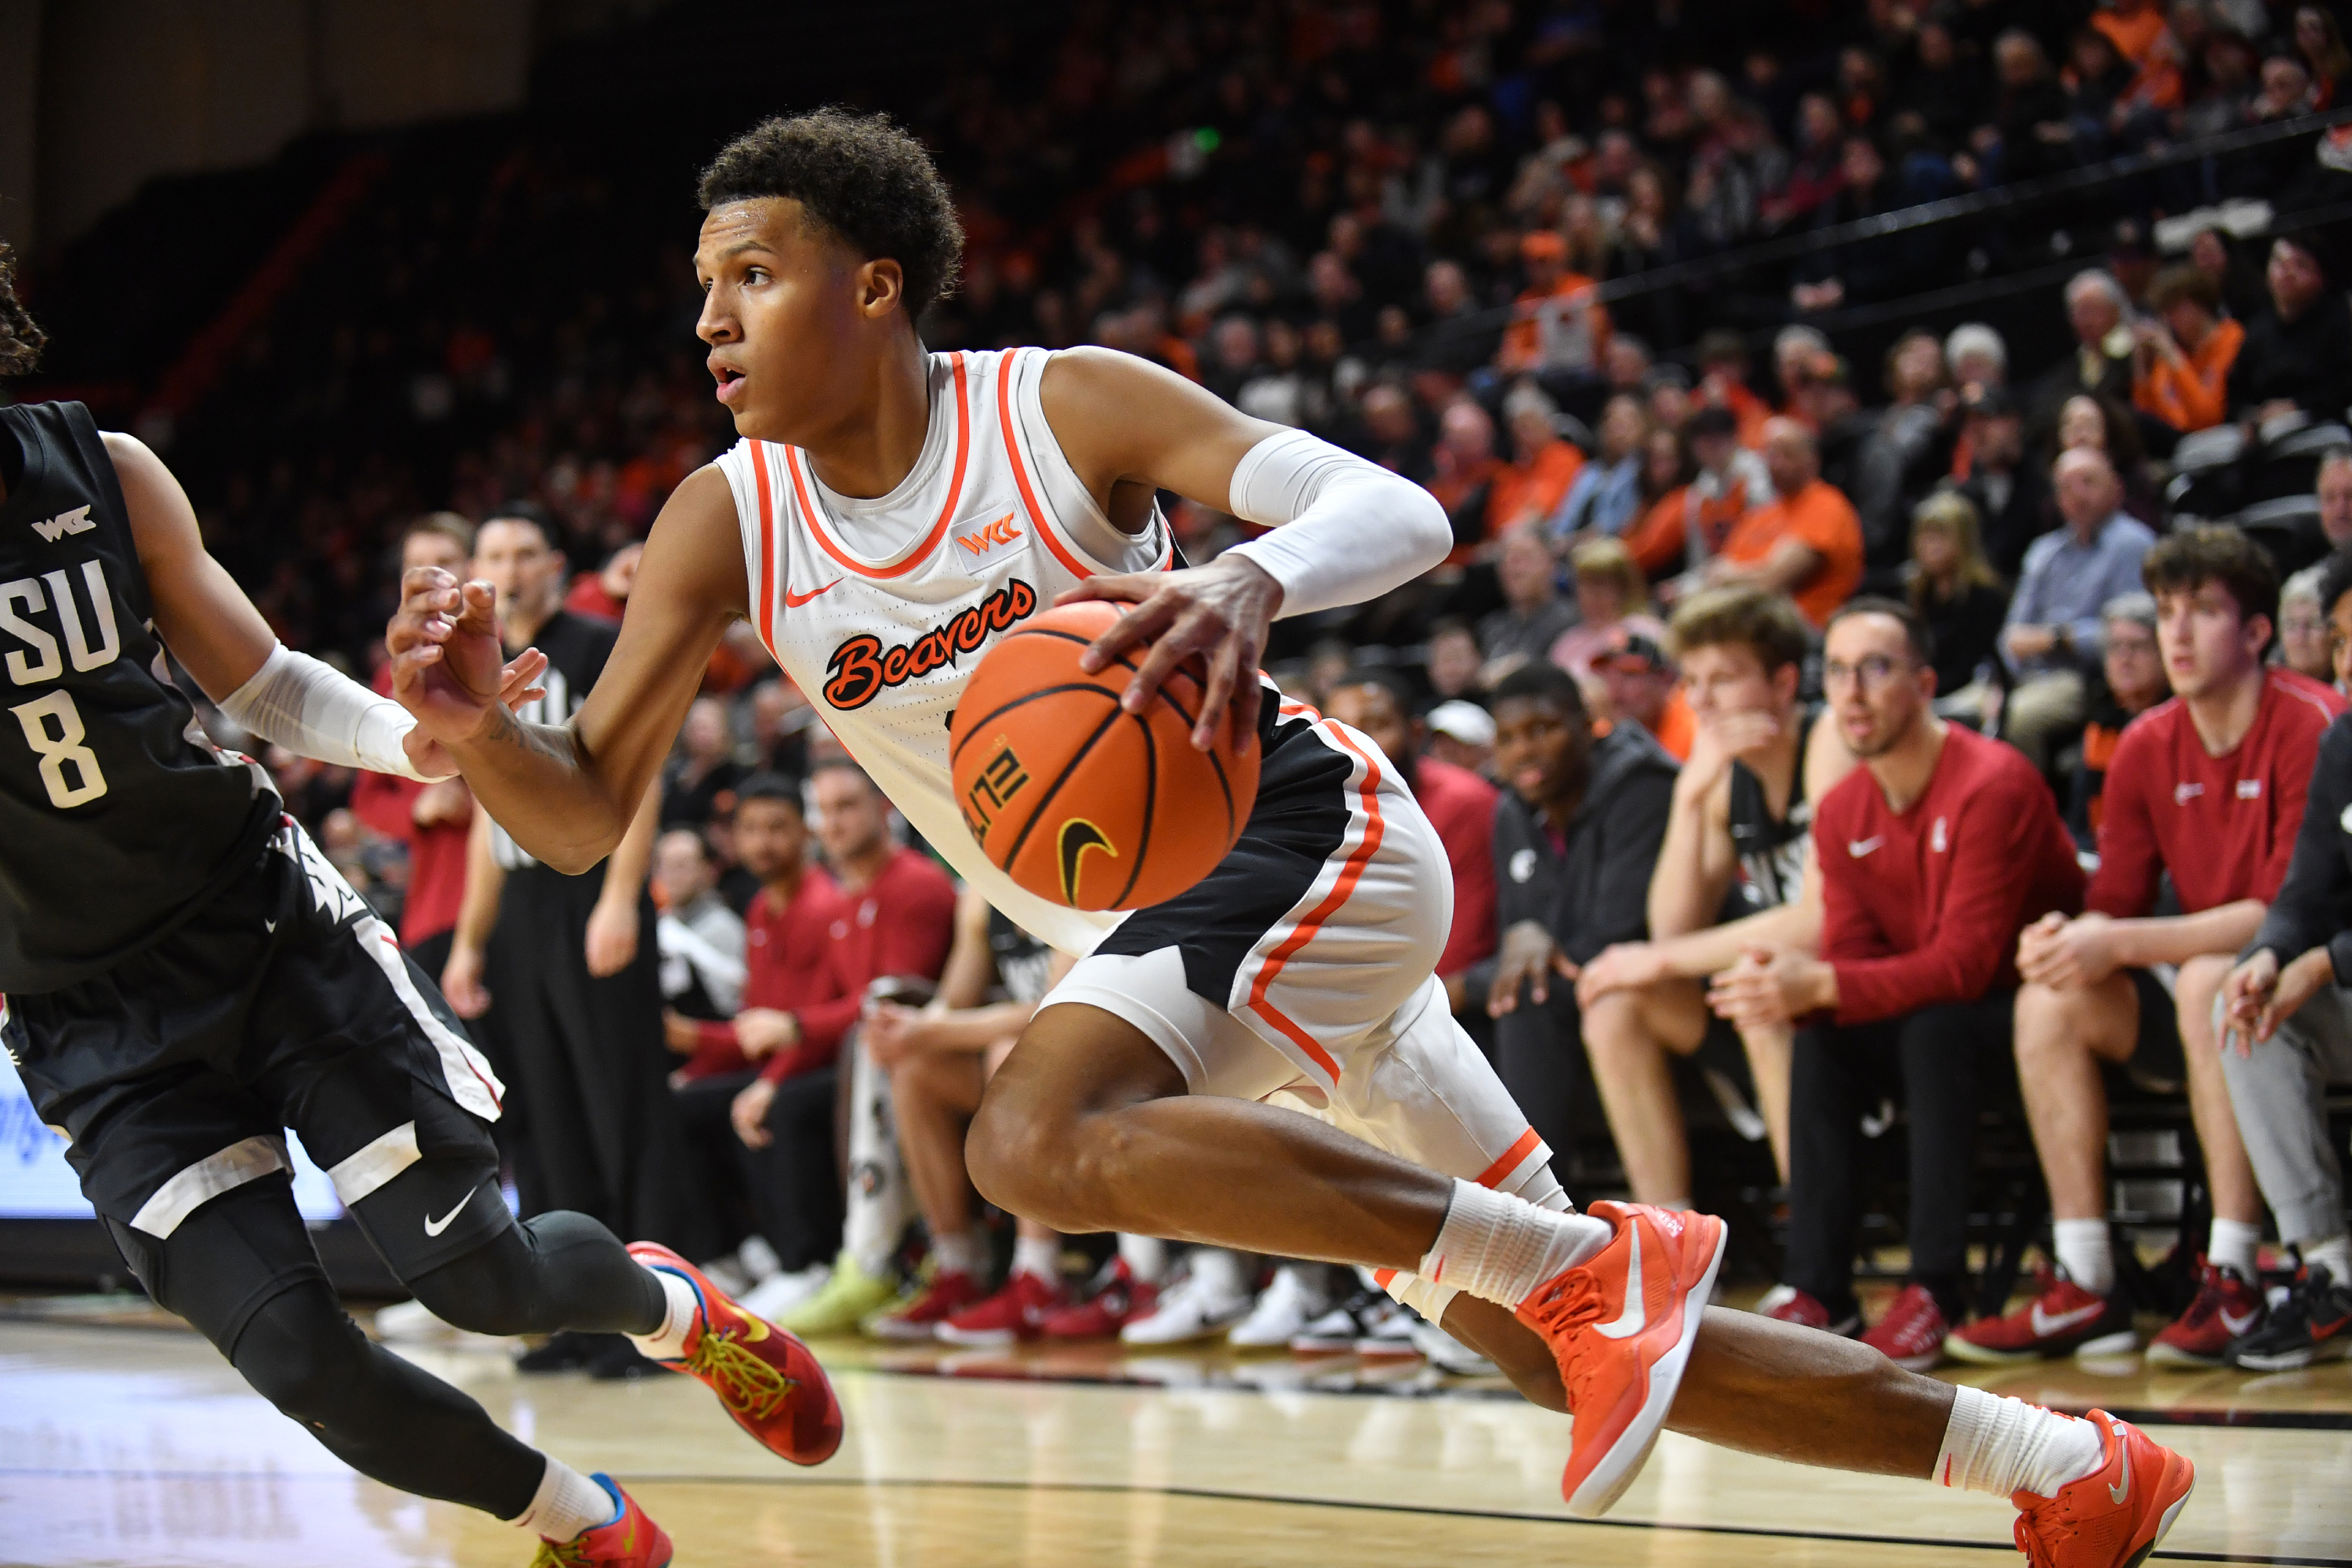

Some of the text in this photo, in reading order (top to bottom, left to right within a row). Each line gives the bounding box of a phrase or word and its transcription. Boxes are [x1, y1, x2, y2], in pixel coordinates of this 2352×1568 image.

[31, 504, 96, 543] WCC
[956, 511, 1022, 557] WCC
[822, 578, 1036, 711] Beavers
[8, 689, 107, 808] 8
